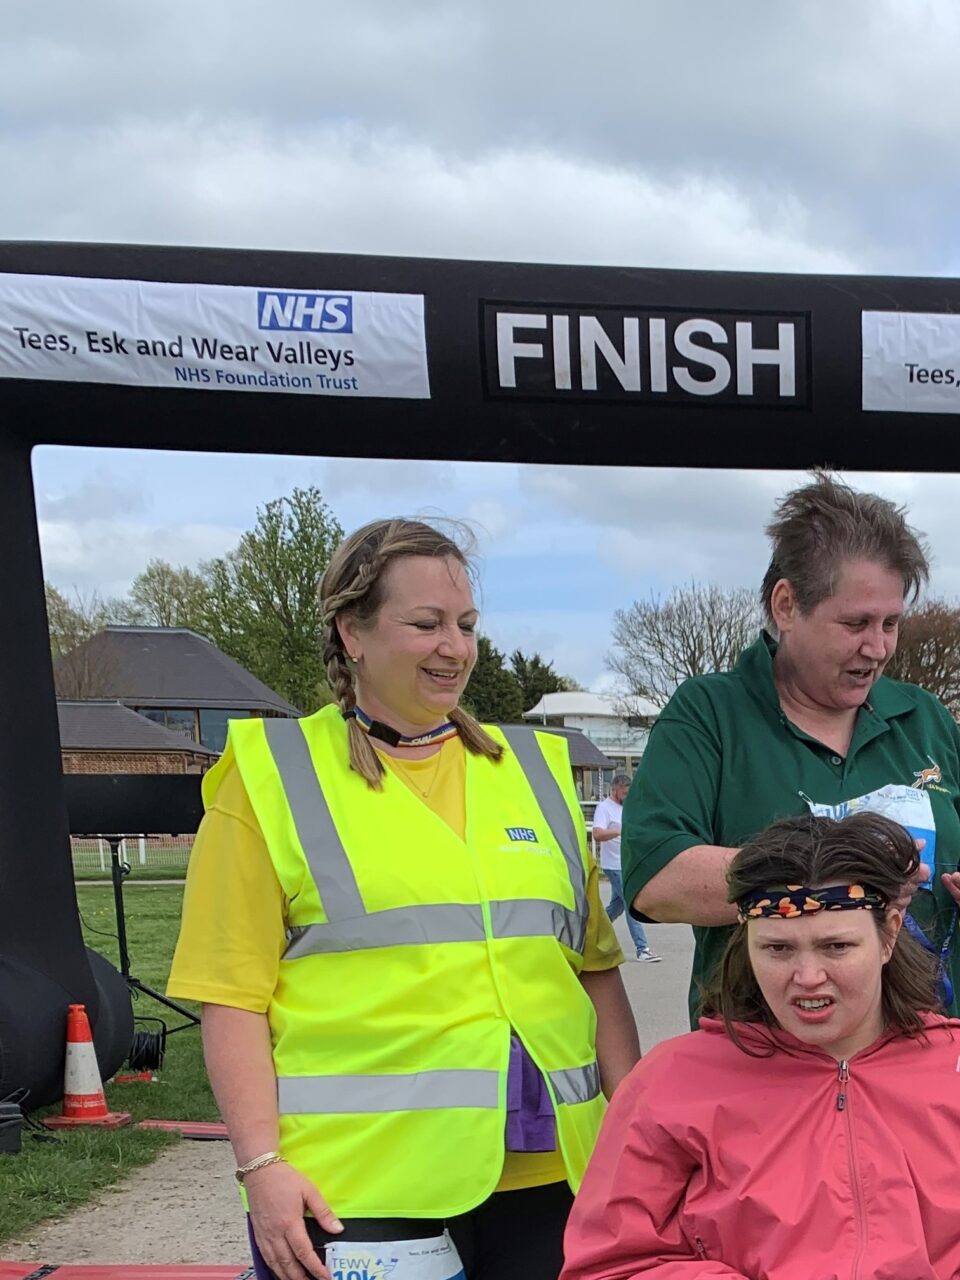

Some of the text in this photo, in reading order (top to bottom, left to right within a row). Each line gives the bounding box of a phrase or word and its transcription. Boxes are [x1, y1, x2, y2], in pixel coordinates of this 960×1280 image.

[260, 293, 349, 331] NHS
[13, 327, 355, 372] Tees, Esk and Wear Valleys
[496, 311, 796, 397] FINISH
[175, 366, 359, 391] NHS Foundation Trust
[905, 363, 960, 388] Tees,
[508, 829, 536, 842] NHS
[332, 1257, 371, 1269] TEWV
